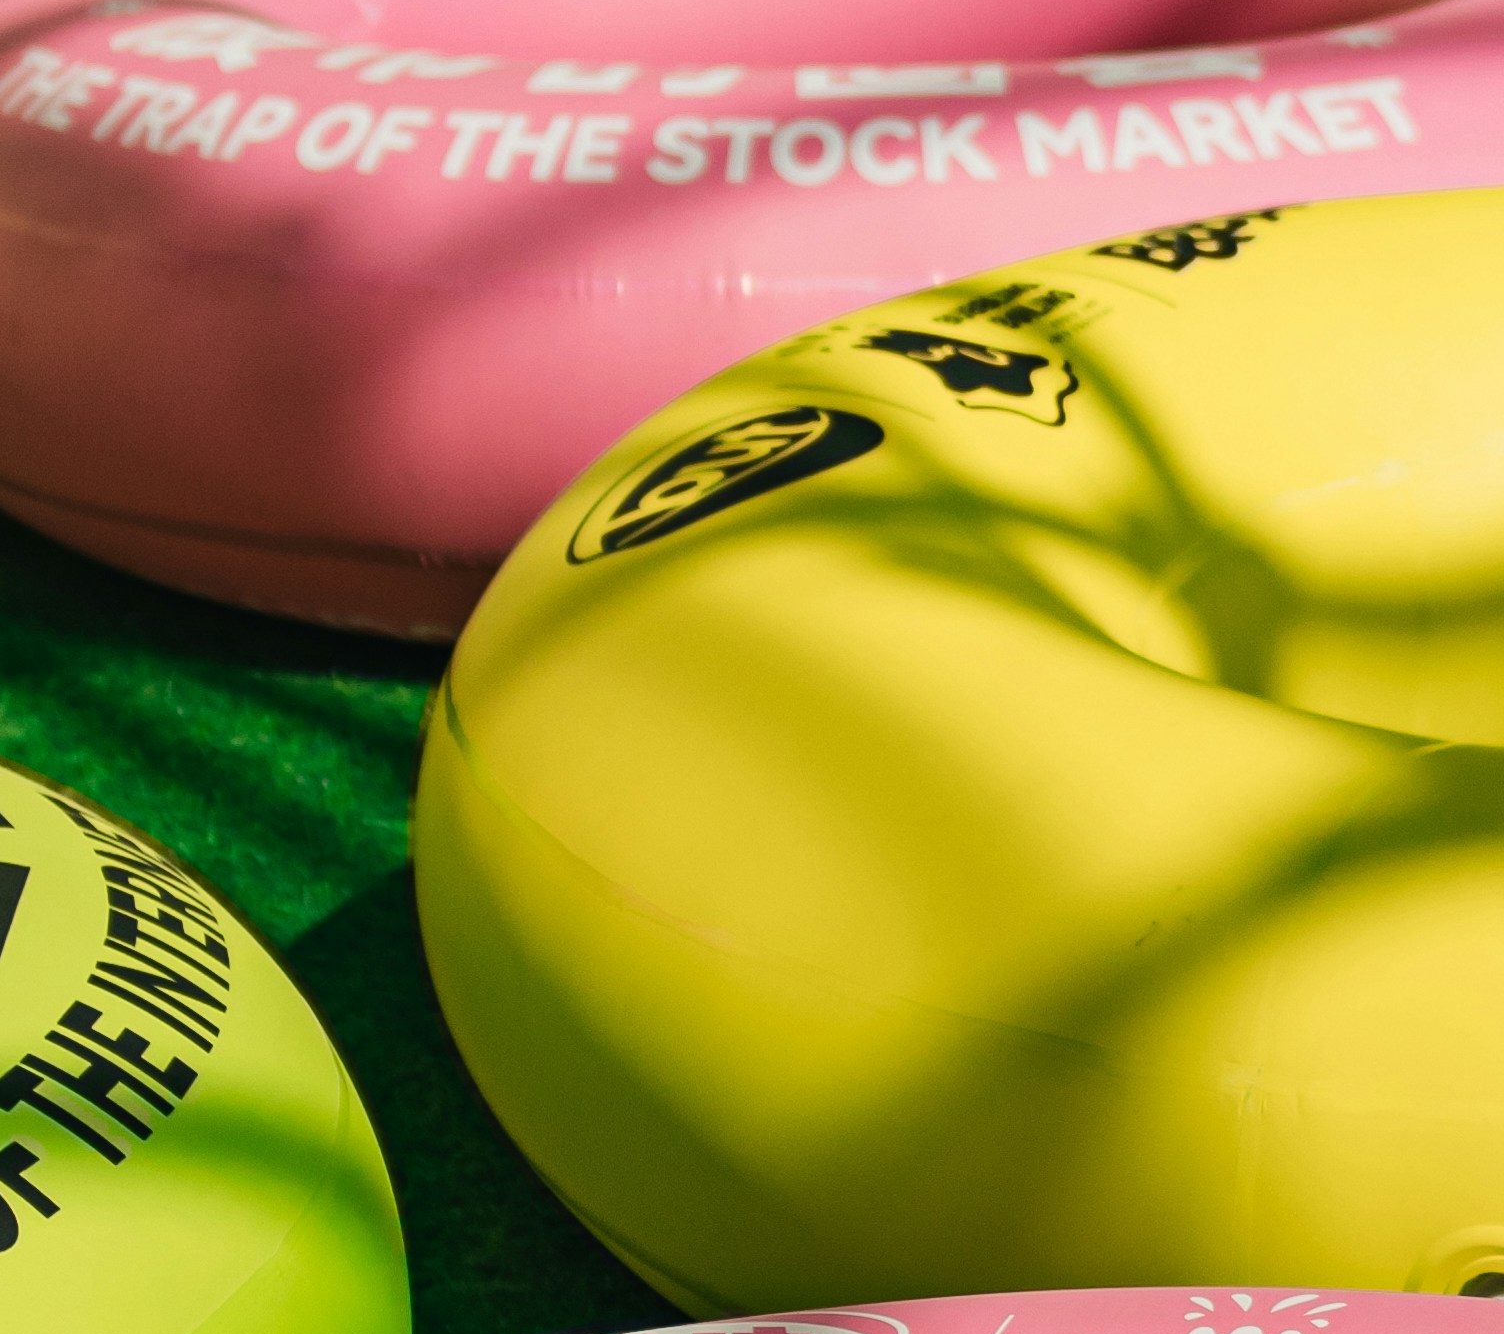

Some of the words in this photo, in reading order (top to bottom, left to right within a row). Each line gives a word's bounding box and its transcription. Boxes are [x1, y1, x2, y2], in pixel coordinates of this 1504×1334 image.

[91, 75, 297, 163] TRAP
[295, 101, 432, 175] OF
[441, 111, 631, 184] THE
[646, 112, 997, 186] STOCK
[1015, 78, 1421, 177] MARKET
